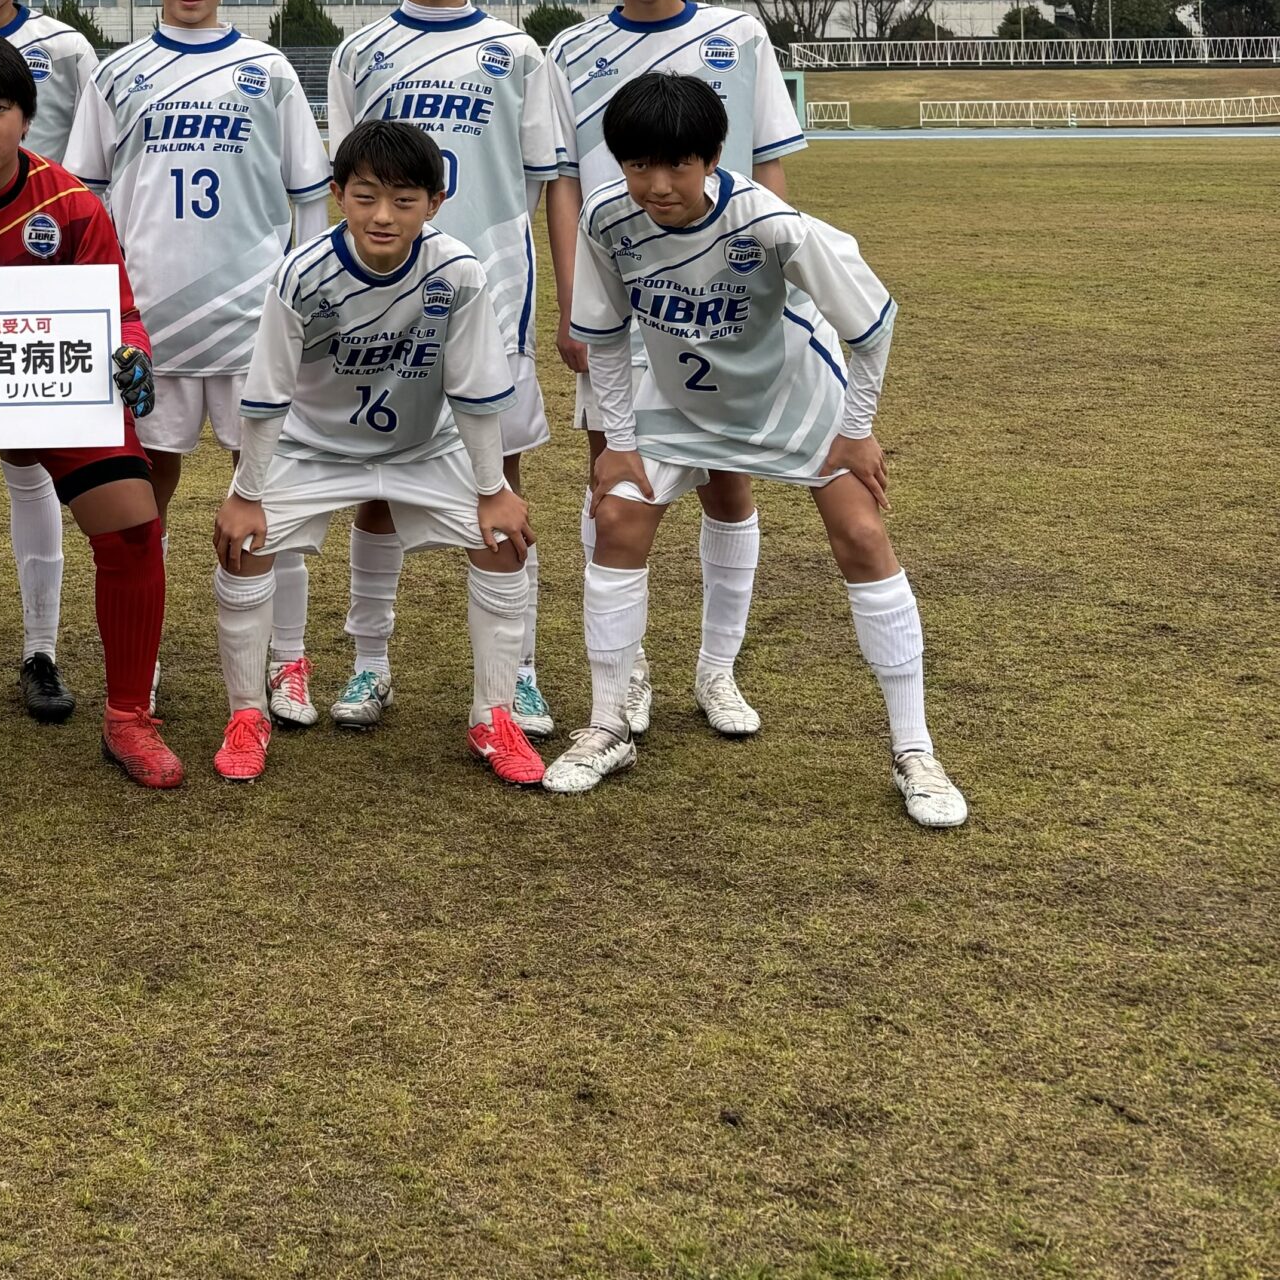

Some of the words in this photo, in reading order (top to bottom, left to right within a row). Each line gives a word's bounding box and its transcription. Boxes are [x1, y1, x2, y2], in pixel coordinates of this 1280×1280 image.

[705, 50, 735, 58] LIBRE
[390, 80, 455, 92] FOOTBALL
[460, 81, 493, 95] CLUB
[149, 101, 213, 111] FOOTBALL
[218, 101, 249, 113] CLUB
[382, 93, 494, 124] LIBRE
[144, 114, 253, 142] LIBRE
[452, 123, 483, 136] 2016
[146, 142, 205, 153] FUKUOKA
[213, 142, 244, 154] 2016
[170, 168, 220, 219] 13
[637, 277, 706, 297] FOOTBALL
[711, 282, 746, 294] CLUB
[630, 286, 751, 327] LIBRE
[637, 315, 701, 339] FUKUOKA
[710, 325, 744, 340] 2016
[328, 339, 441, 368] LIBRE
[678, 352, 718, 392] 2
[349, 386, 398, 433] 16
